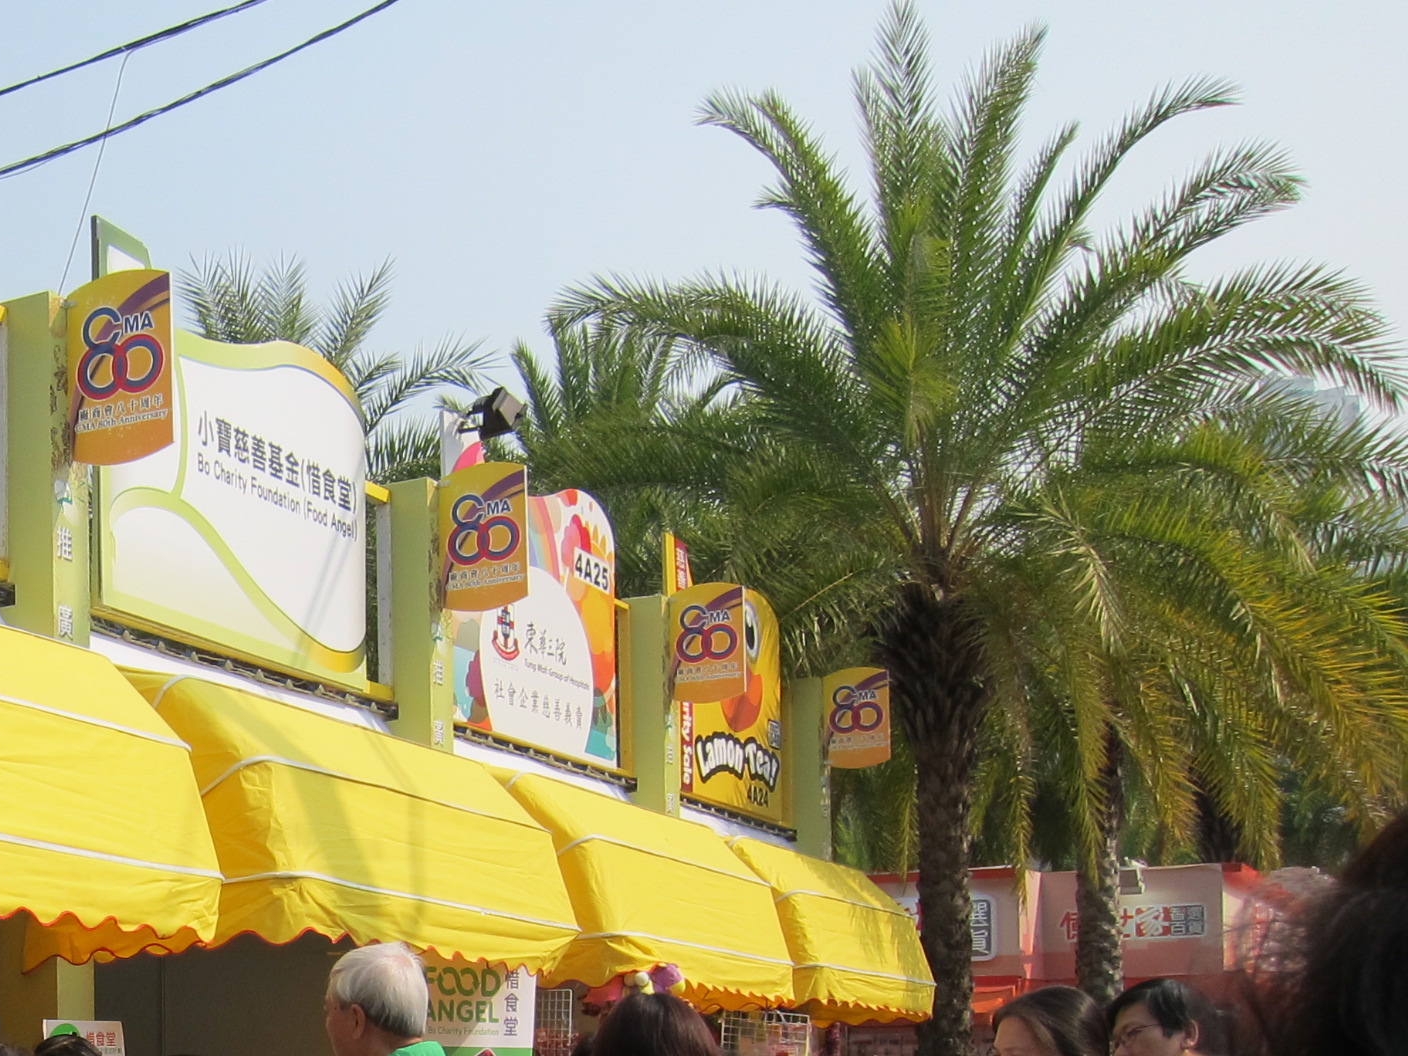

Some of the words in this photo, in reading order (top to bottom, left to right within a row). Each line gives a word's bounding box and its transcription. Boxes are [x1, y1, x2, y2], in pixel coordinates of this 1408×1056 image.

[82, 306, 154, 349] CMA
[78, 312, 164, 401] 80
[76, 422, 97, 434] CMA
[98, 417, 117, 429] 80th
[119, 410, 168, 425] Anniversary
[79, 394, 164, 421] 廠商會八十周年
[198, 410, 357, 515] 小寶慈善基金(惜食堂)
[197, 452, 211, 476] Bo
[213, 460, 248, 495] Charity
[251, 476, 301, 515] Foundation
[303, 497, 328, 528] (Food
[331, 513, 358, 542] Angel)
[452, 494, 513, 524] CMA
[447, 498, 522, 567] 80
[57, 525, 74, 641] 推廣
[575, 553, 609, 590] 4A25
[676, 609, 738, 663] 80
[680, 605, 731, 629] CMA
[524, 621, 567, 666] 東華三院
[829, 689, 884, 734] 80
[833, 686, 877, 707] CMA
[683, 744, 693, 785] Sale
[695, 735, 745, 781] Lamon
[747, 784, 769, 808] 4A24
[427, 999, 500, 1024] ANGEL
[503, 970, 520, 1037] 惜食堂
[438, 1027, 462, 1036] Charity
[464, 1028, 499, 1036] Foundation
